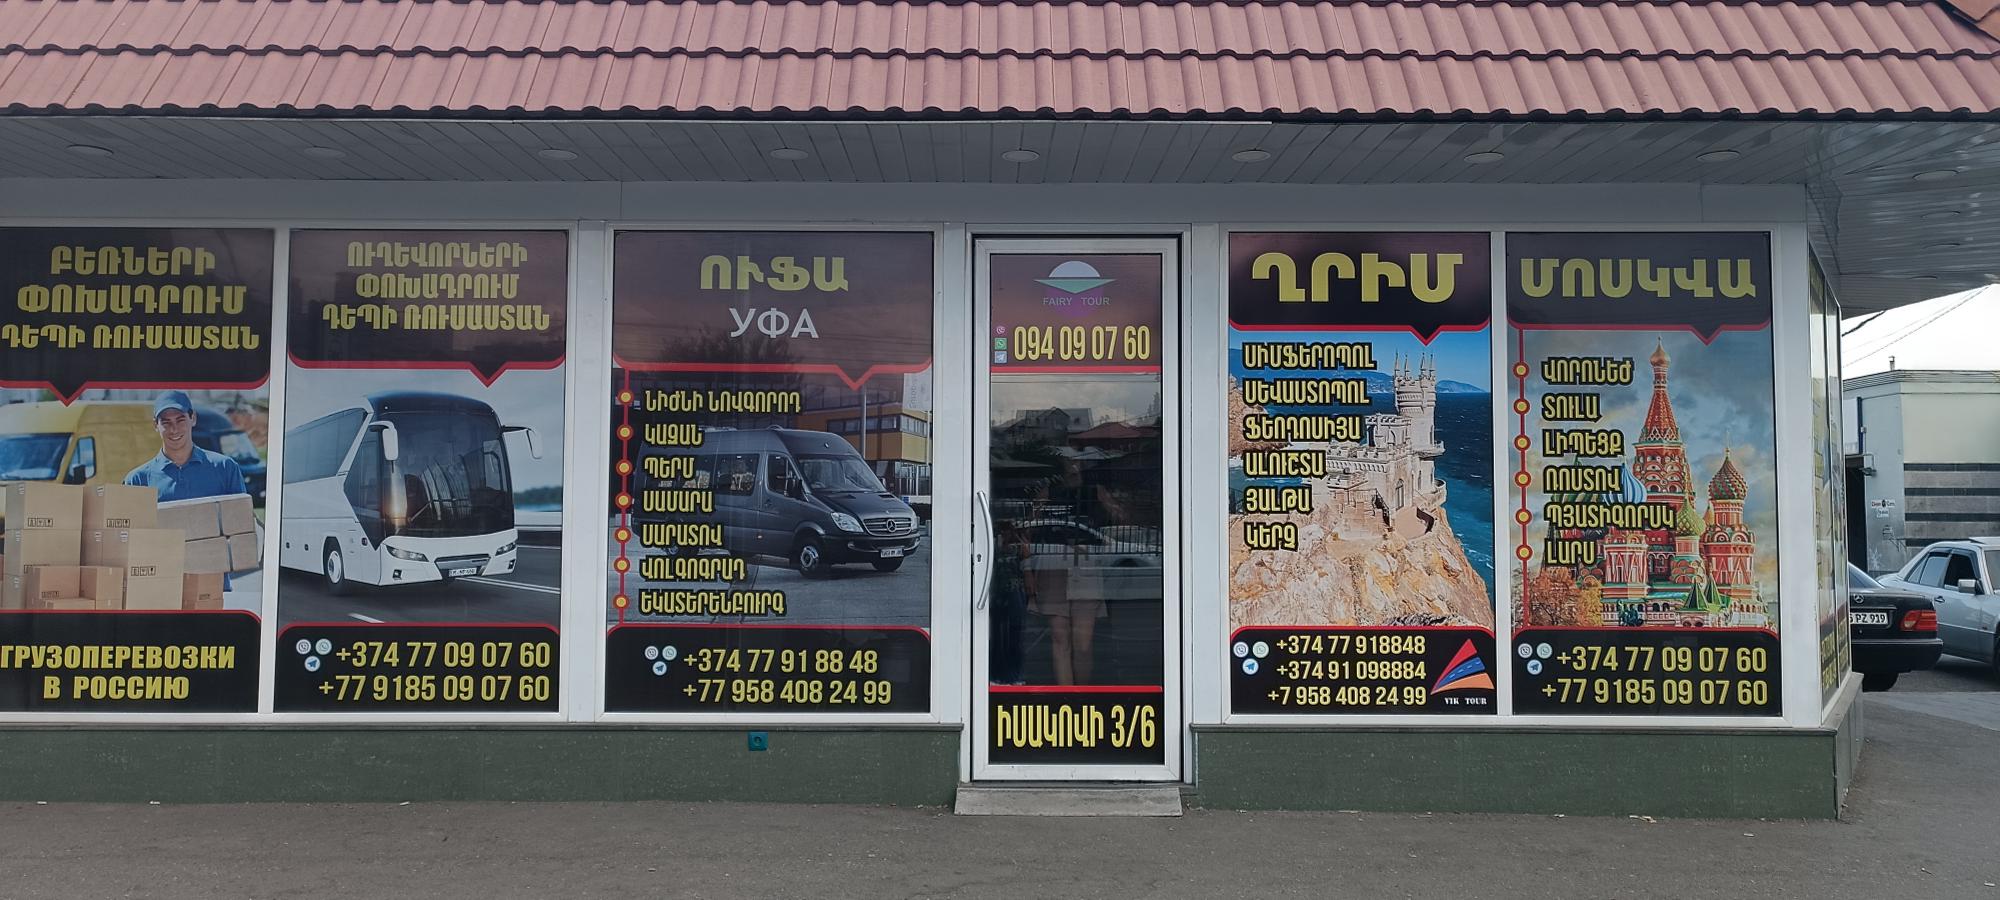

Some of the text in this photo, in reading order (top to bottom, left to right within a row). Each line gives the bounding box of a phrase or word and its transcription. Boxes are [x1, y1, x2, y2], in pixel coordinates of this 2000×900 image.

[51, 246, 215, 275] ԲԵՌՆԵՐԻ
[347, 241, 528, 267] ՈՒՂԵՎՈՐՆԵՐԻ
[700, 255, 849, 291] ՈՒՖԱ
[1252, 252, 1463, 303] ՂՐԻՄ
[1520, 258, 1756, 298] ՄՈՍԿՎԱ
[356, 273, 519, 298] ՓՈԽԱԴՐՈՒՄ
[17, 284, 247, 314] ՓՈԽԱԴՐՈՒՄ
[1042, 297, 1110, 306] FAIRY TOUR
[322, 303, 549, 330] ԴԵՊԻ ՌՈՒՍԱՍՏԱՆ
[728, 307, 819, 339] УФА
[2, 324, 260, 350] ԴԵՊԻ ՌՈՒՍԱՍՏԱՆ
[1014, 325, 1150, 360] 094 09 07 60
[1245, 345, 1375, 368] ՍԻՄՖԵՐՈՊՈԼ
[1544, 359, 1632, 383] ՎՈՐՈՆԵԺ
[645, 391, 801, 413] ՆԻԺՆԻ ՆՈՎԳՈՐՈԴ
[1245, 380, 1370, 404] ՍԵՎԱՍՏՈՊՈԼ
[1544, 395, 1599, 419] ՏՈՒԼԱ
[645, 424, 703, 446] ԿԱԶԱՆ
[1246, 416, 1361, 440] ՖԵՈԴՈՍԻՅԱ
[1545, 431, 1622, 455] ԼԻՊԵՑՔ
[644, 457, 695, 479] ՊԵՐՄ
[1246, 452, 1325, 477] ԱԼՈՒՇՏԱ
[1546, 468, 1620, 492] ՌՈՍՏՈՎ
[643, 490, 713, 513] ՍԱՄԱՐԱ
[1246, 488, 1310, 512] ՅԱԼԹԱ
[1547, 503, 1674, 529] ՊՅԱՏԻԳՈՐՍԿ
[642, 524, 723, 547] ՍԱՐԱՏՈՎ
[1246, 525, 1296, 549] ԿԵՐՉ
[1547, 540, 1595, 564] ԼԱՐՍ
[642, 557, 746, 581] ՎՈԼԳՈԳՐԱԴ
[641, 590, 785, 615] ԵԿԱՏԵՐԵՆԲՈՒՐԳ
[1870, 613, 1885, 623] 919
[0, 645, 235, 670] ГРУЗОПЕРЕВОЗКИ
[336, 642, 550, 668] +374 77 09 07 60
[1276, 636, 1426, 655] +374 77 918848
[684, 649, 878, 673] +374 77 91 88 48
[1276, 661, 1426, 680] +374 91 098884
[1556, 646, 1767, 672] +374 77 09 07 60
[43, 676, 190, 699] В РОССИЮ
[318, 676, 366, 701] +77
[443, 676, 474, 701] 09
[481, 676, 512, 701] 07
[519, 676, 550, 701] 60
[683, 680, 892, 704] +77 958 408 24 99
[1268, 687, 1427, 706] +7 958 408 24 99
[1542, 678, 1588, 703] +77
[1663, 680, 1693, 704] 09
[1700, 680, 1730, 705] 07
[1737, 680, 1768, 705] 60
[1444, 697, 1487, 705] VIK TOUR
[997, 705, 1156, 748] ԻՍԱԿՈՎԻ 3/6
